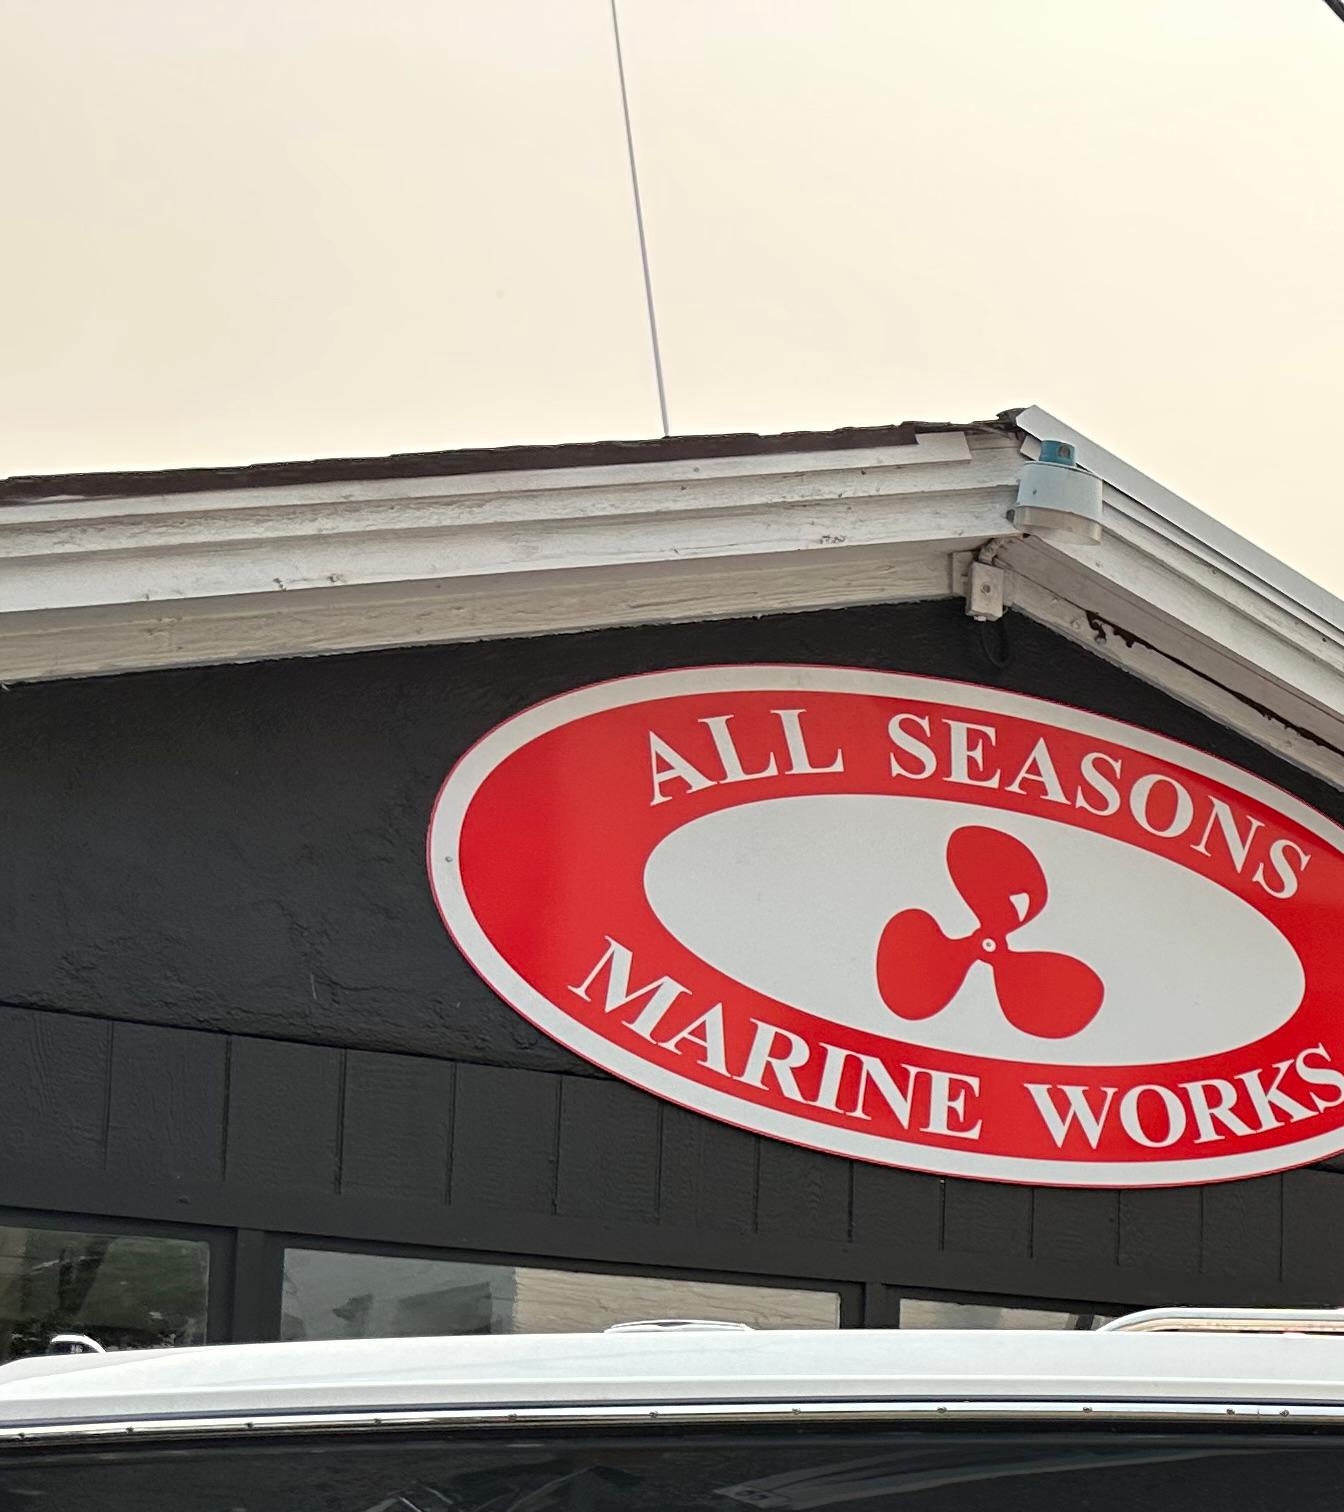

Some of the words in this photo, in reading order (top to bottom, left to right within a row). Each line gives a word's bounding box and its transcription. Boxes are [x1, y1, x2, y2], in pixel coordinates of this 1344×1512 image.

[649, 709, 844, 806] ALL
[888, 713, 1311, 899] SEASONS
[568, 936, 982, 1140] MARINE
